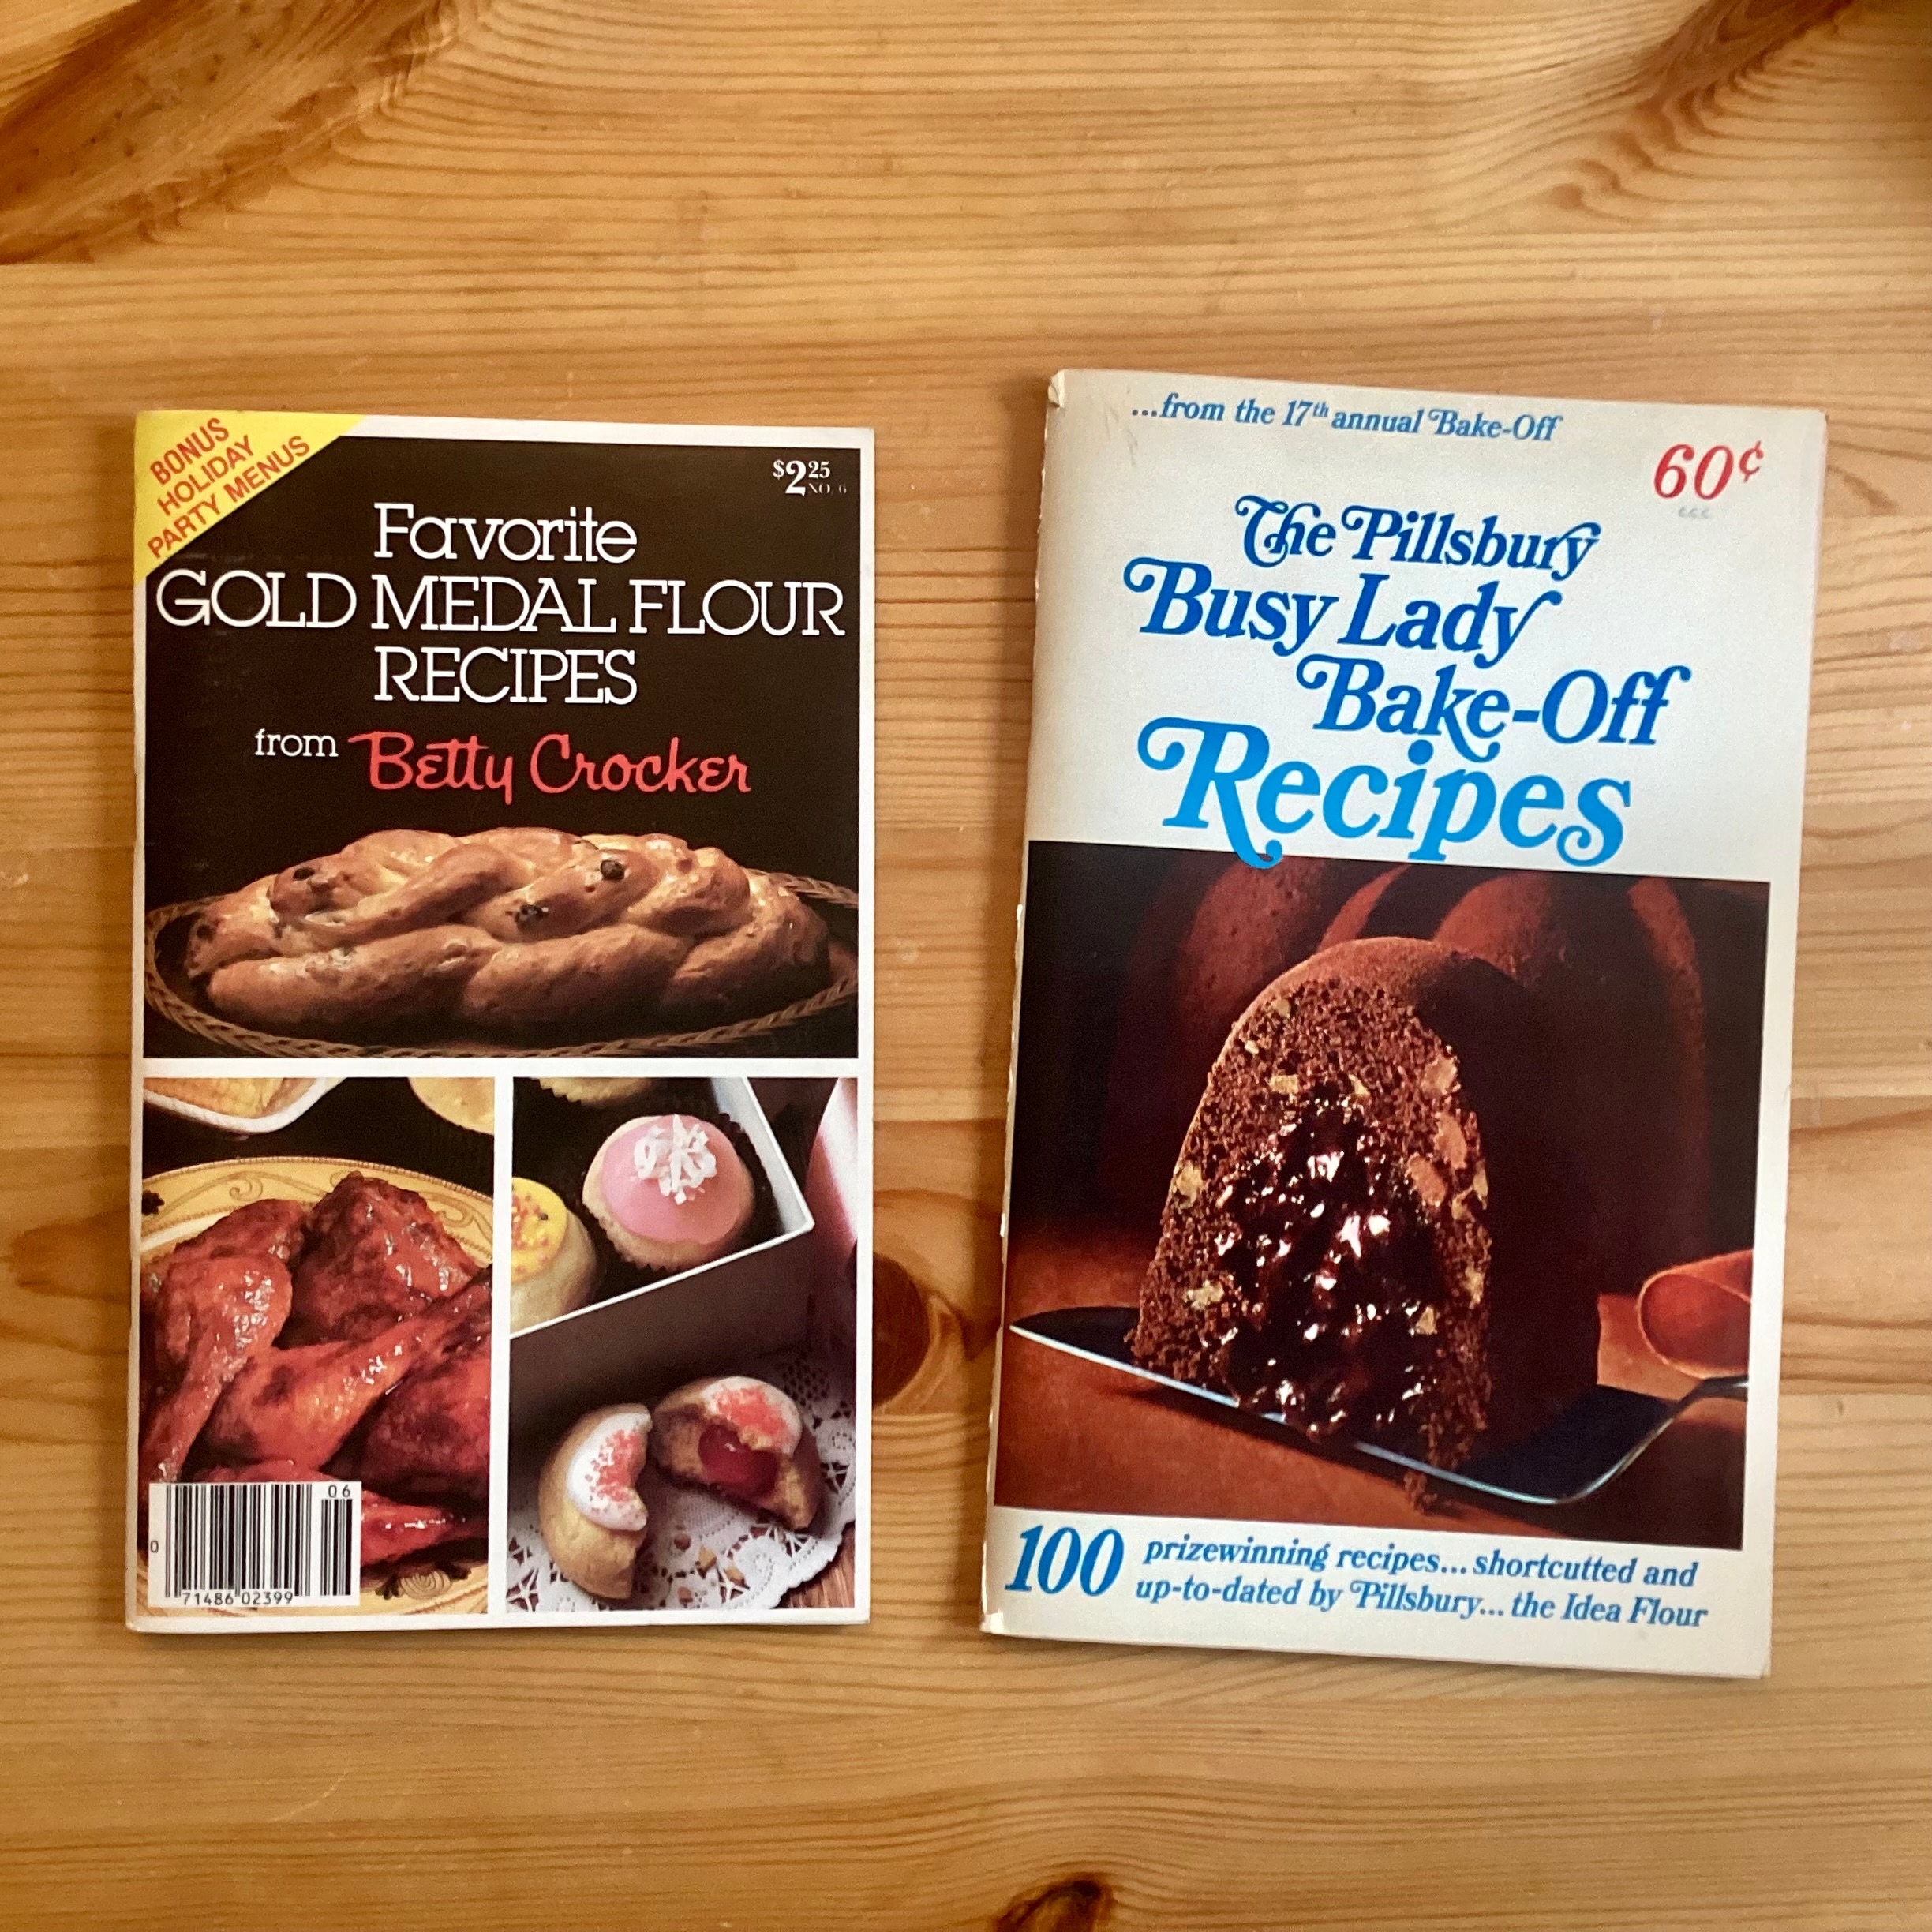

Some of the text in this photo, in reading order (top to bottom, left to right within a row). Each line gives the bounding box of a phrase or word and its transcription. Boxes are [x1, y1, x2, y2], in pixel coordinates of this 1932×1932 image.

[150, 417, 230, 487] BONUS
[1234, 399, 1276, 426] the
[1331, 408, 1422, 434] annual
[1428, 409, 1563, 442] Bake-Off
[147, 436, 310, 558] PARTY MENUS
[157, 435, 254, 516] HOLIDAY
[1654, 440, 1764, 500] 60¢
[373, 502, 638, 564] Favorite
[1235, 495, 1602, 582] The Pillsbury
[156, 569, 845, 636] GOLD MEDAL FLOUR
[1123, 557, 1563, 669] Busy Lady
[374, 646, 638, 705] RECIPES
[1296, 655, 1691, 763] Bake-Off
[254, 728, 751, 805] from Betty Crocker
[1137, 716, 1633, 868] Recipes
[1004, 1525, 1698, 1597] 100 prizewinning recipes... shortcutted and
[1135, 1575, 1709, 1628] up-to-dated by Pillsbury... the Idea Flour
